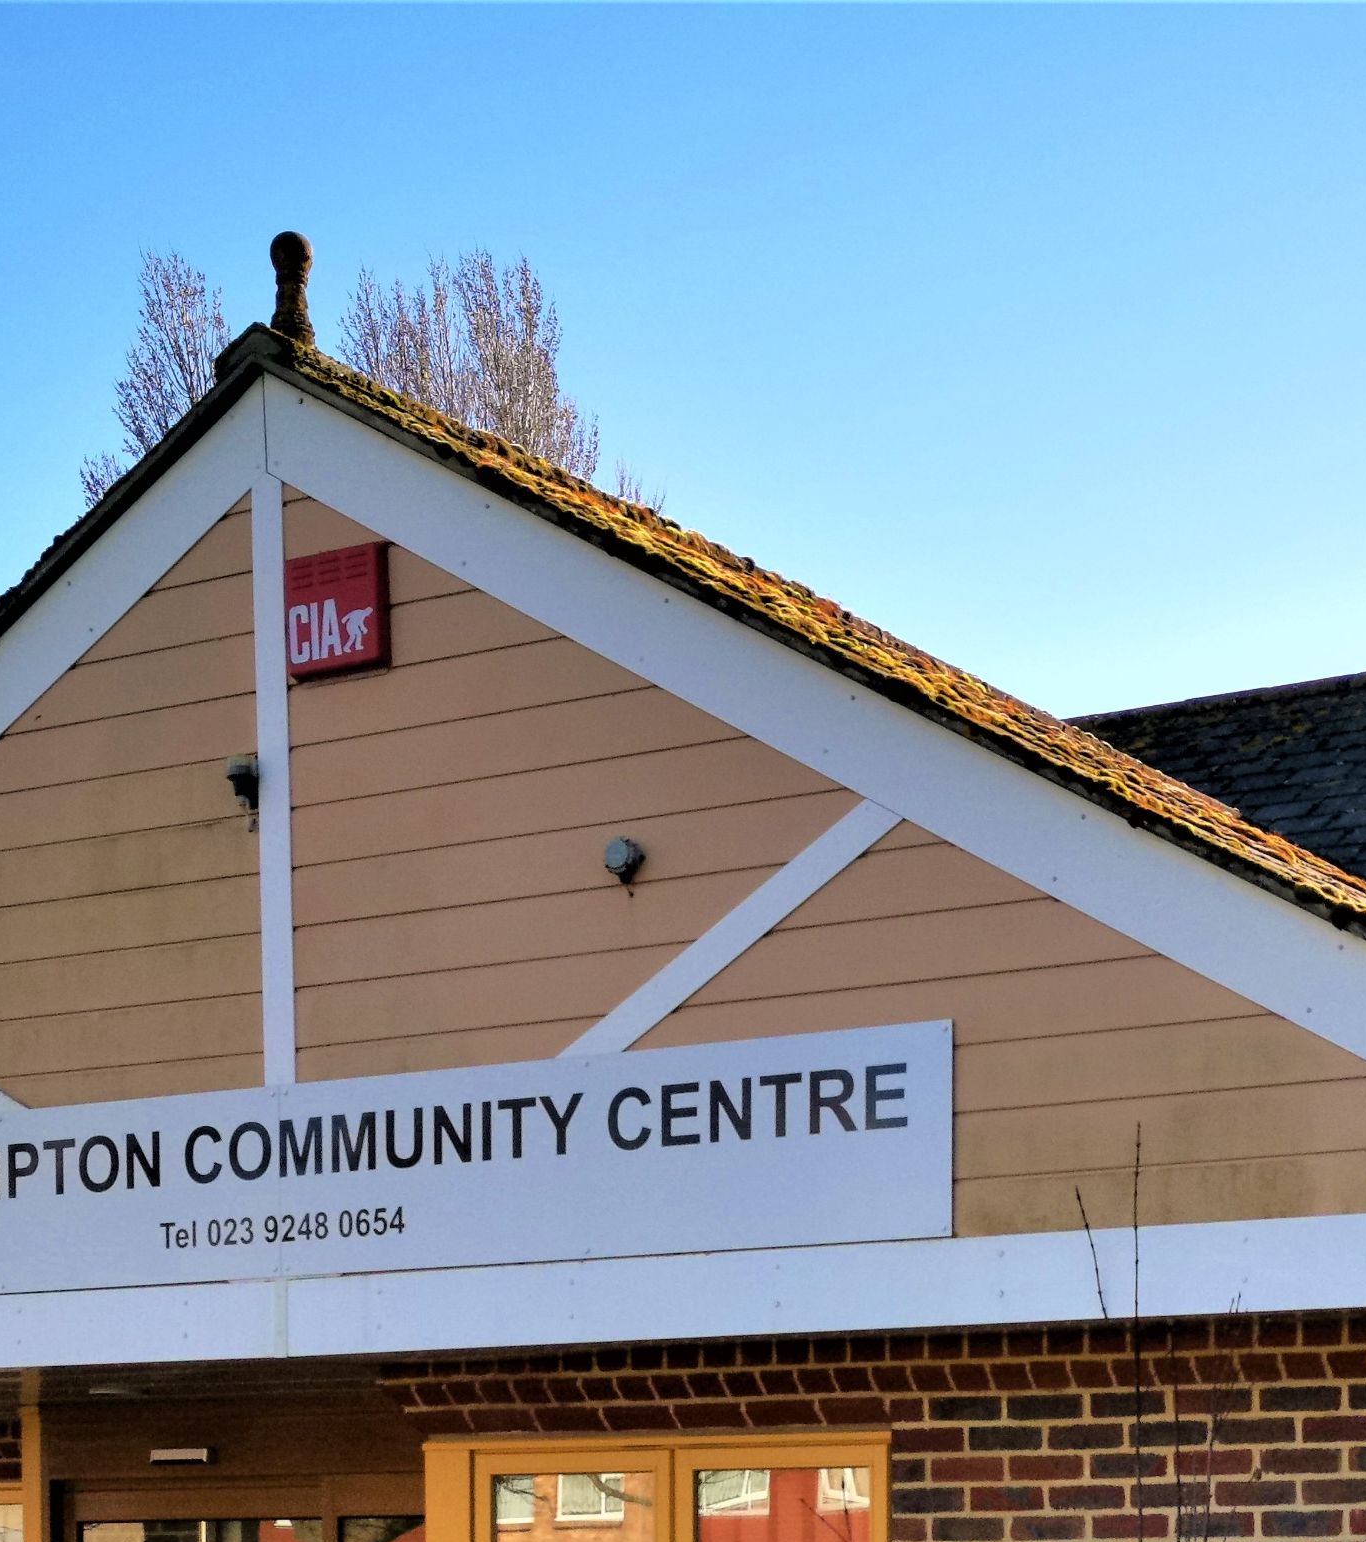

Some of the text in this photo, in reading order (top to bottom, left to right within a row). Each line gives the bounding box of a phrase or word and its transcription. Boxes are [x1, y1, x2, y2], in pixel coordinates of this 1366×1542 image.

[288, 598, 342, 664] CIA
[184, 1092, 584, 1185] COMMUNITY
[607, 1062, 909, 1151] CENTRE
[159, 1206, 405, 1249] Tel 023 9248 0654
